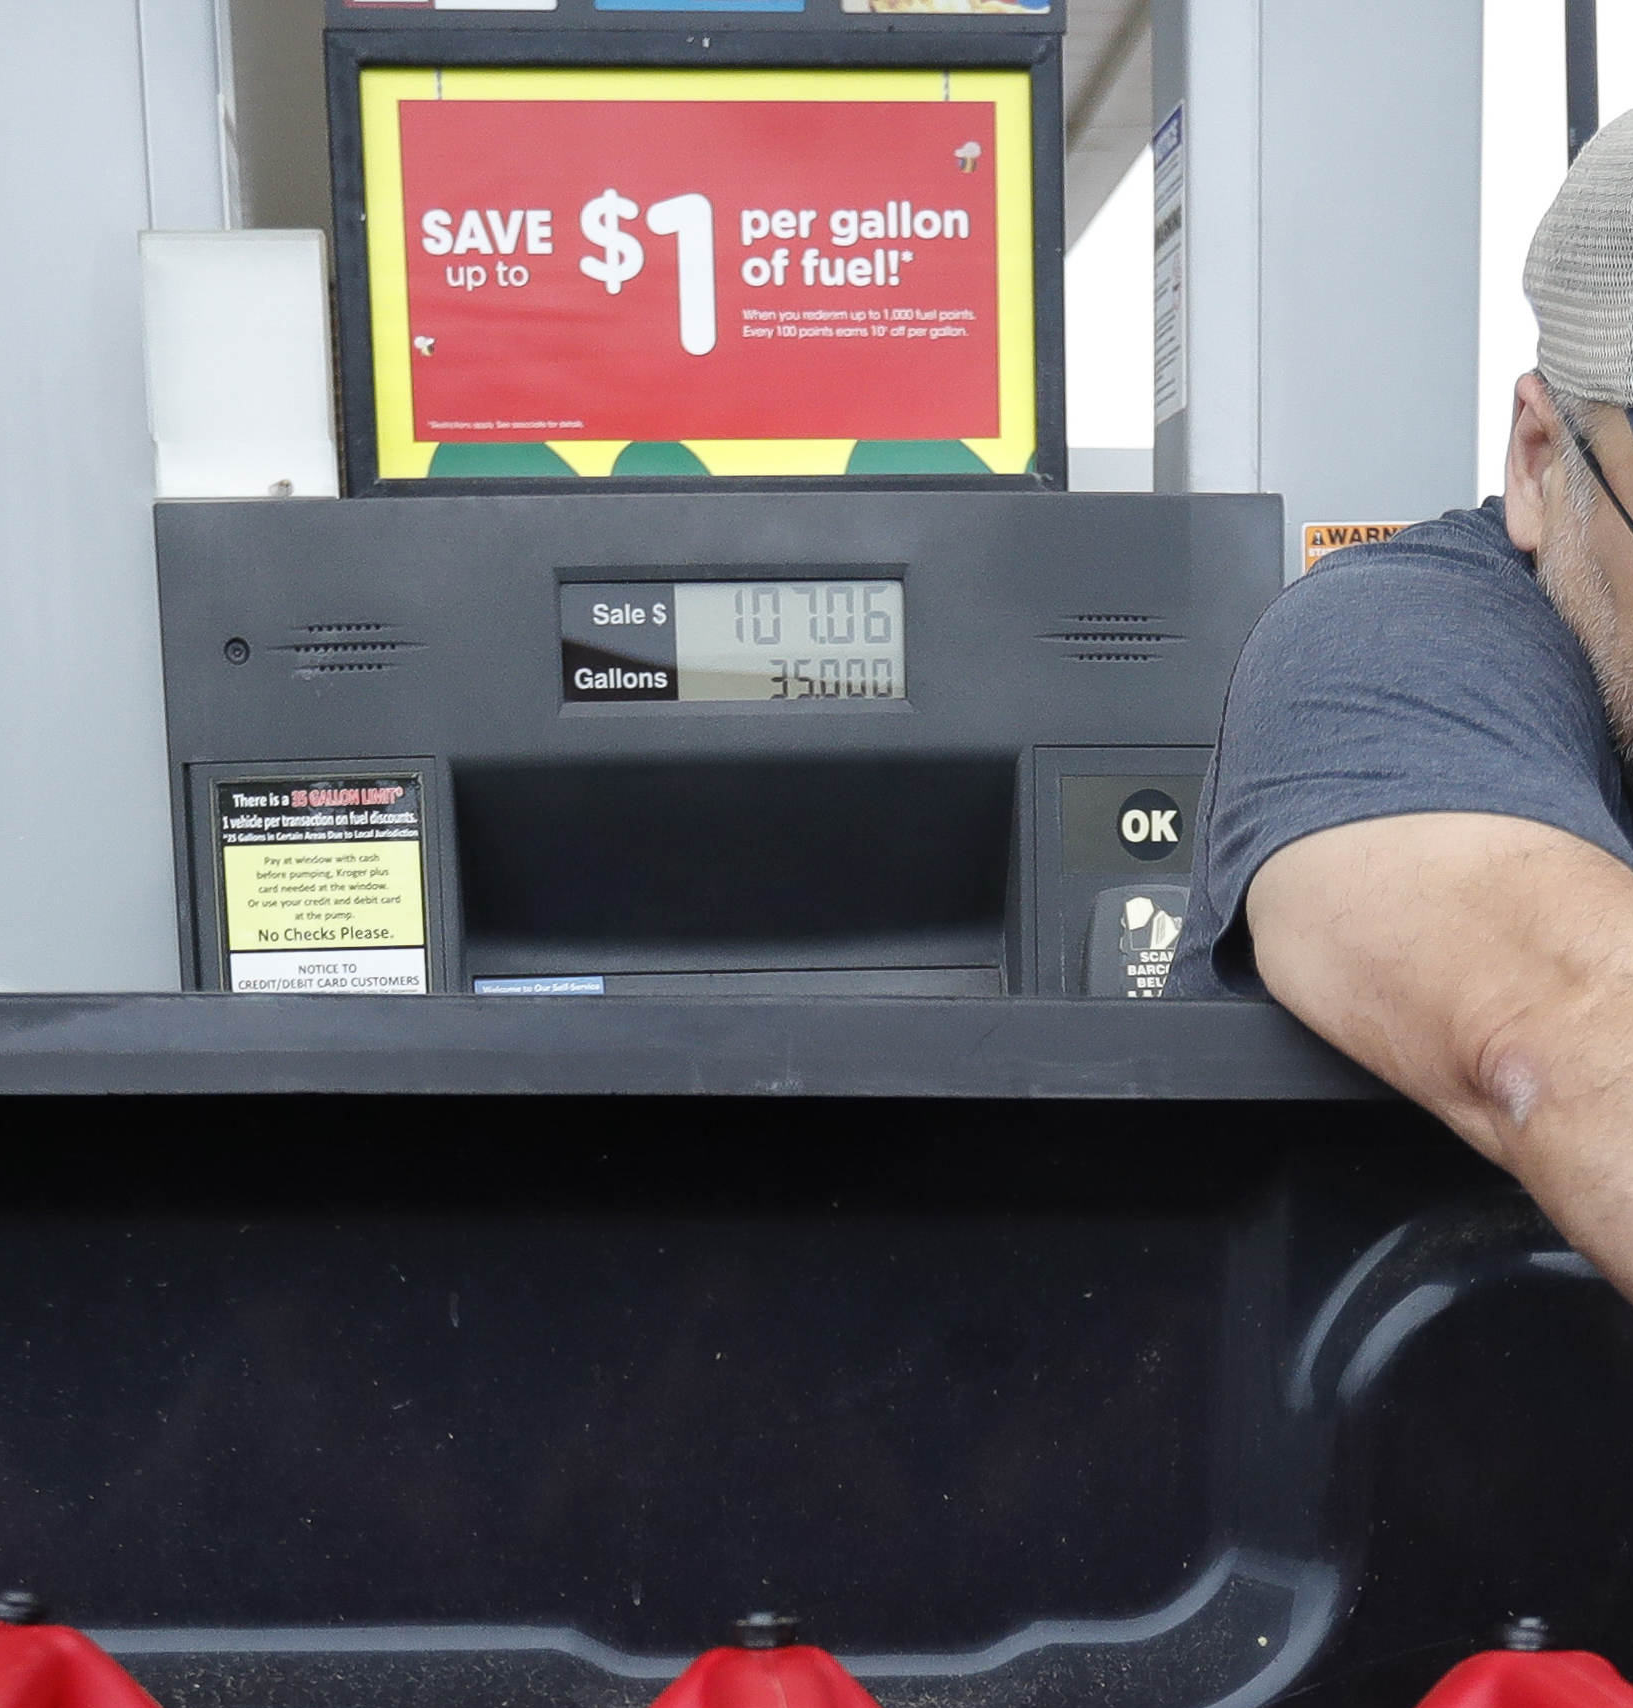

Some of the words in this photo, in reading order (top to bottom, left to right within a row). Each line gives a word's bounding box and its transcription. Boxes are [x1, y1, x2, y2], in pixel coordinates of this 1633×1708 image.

[421, 208, 553, 256] SAVE
[741, 205, 816, 250] per
[831, 202, 970, 248] gallon
[447, 262, 485, 290] up
[495, 261, 530, 288] to
[579, 188, 717, 356] $1
[743, 250, 793, 286] of
[742, 309, 776, 320] When
[779, 310, 800, 322] you
[850, 310, 866, 322] up
[868, 309, 881, 320] to
[883, 309, 913, 321] 1,000
[915, 308, 937, 320] fuel
[742, 326, 774, 338] Every
[777, 325, 797, 337] 100
[798, 325, 834, 338] points
[836, 327, 868, 337] earns
[890, 325, 906, 336] off
[907, 326, 927, 338] per
[593, 602, 646, 626] Sale
[652, 603, 667, 627] $
[735, 586, 892, 645] 107.06
[574, 668, 668, 690] Gallons
[233, 793, 267, 808] There
[269, 792, 280, 807] is
[281, 796, 290, 806] a
[292, 790, 308, 808] 35
[309, 788, 361, 807] GALLON
[223, 815, 229, 829] 1
[230, 813, 263, 829] vehicle
[264, 814, 280, 830] per
[281, 812, 335, 828] transaction
[336, 813, 348, 825] on
[350, 811, 369, 825] fuel
[370, 810, 418, 826] discounts.
[1121, 809, 1178, 842] OK
[238, 831, 266, 842] Gallons
[276, 831, 303, 841] Certain
[305, 830, 326, 840] Areas
[328, 830, 343, 840] Due
[344, 830, 353, 839] to
[355, 829, 374, 839] Local
[375, 828, 419, 838] Jurisdiction
[264, 857, 280, 867] Pay
[296, 856, 332, 865] window
[336, 855, 356, 864] with
[359, 854, 380, 863] cash
[257, 870, 287, 879] before
[290, 871, 334, 881] pumping,
[336, 869, 368, 880] Kroger
[370, 868, 389, 879] plus
[258, 884, 278, 893] card
[281, 884, 315, 893] needed
[318, 884, 327, 892] at
[330, 883, 346, 892] the
[348, 882, 388, 891] window.
[248, 899, 260, 908] Or
[281, 899, 301, 910] your
[304, 897, 331, 907] credit
[333, 897, 351, 905] and
[353, 896, 378, 905] debit
[381, 895, 401, 905] card
[295, 912, 304, 920] at
[307, 912, 322, 920] the
[325, 911, 355, 922] pump.
[258, 929, 279, 942] No
[284, 927, 336, 941] Checks
[341, 926, 394, 940] Please.
[298, 964, 339, 975] NOTICE
[342, 963, 357, 974] TO
[1127, 964, 1170, 976] BARC
[238, 978, 314, 991] CREDIT/DEBIT
[317, 978, 347, 989] CARD
[351, 975, 420, 988] CUSTOMERS
[482, 984, 521, 993] Welcome
[523, 984, 533, 993] to
[534, 983, 550, 993] Our
[1136, 977, 1167, 988] BEL
